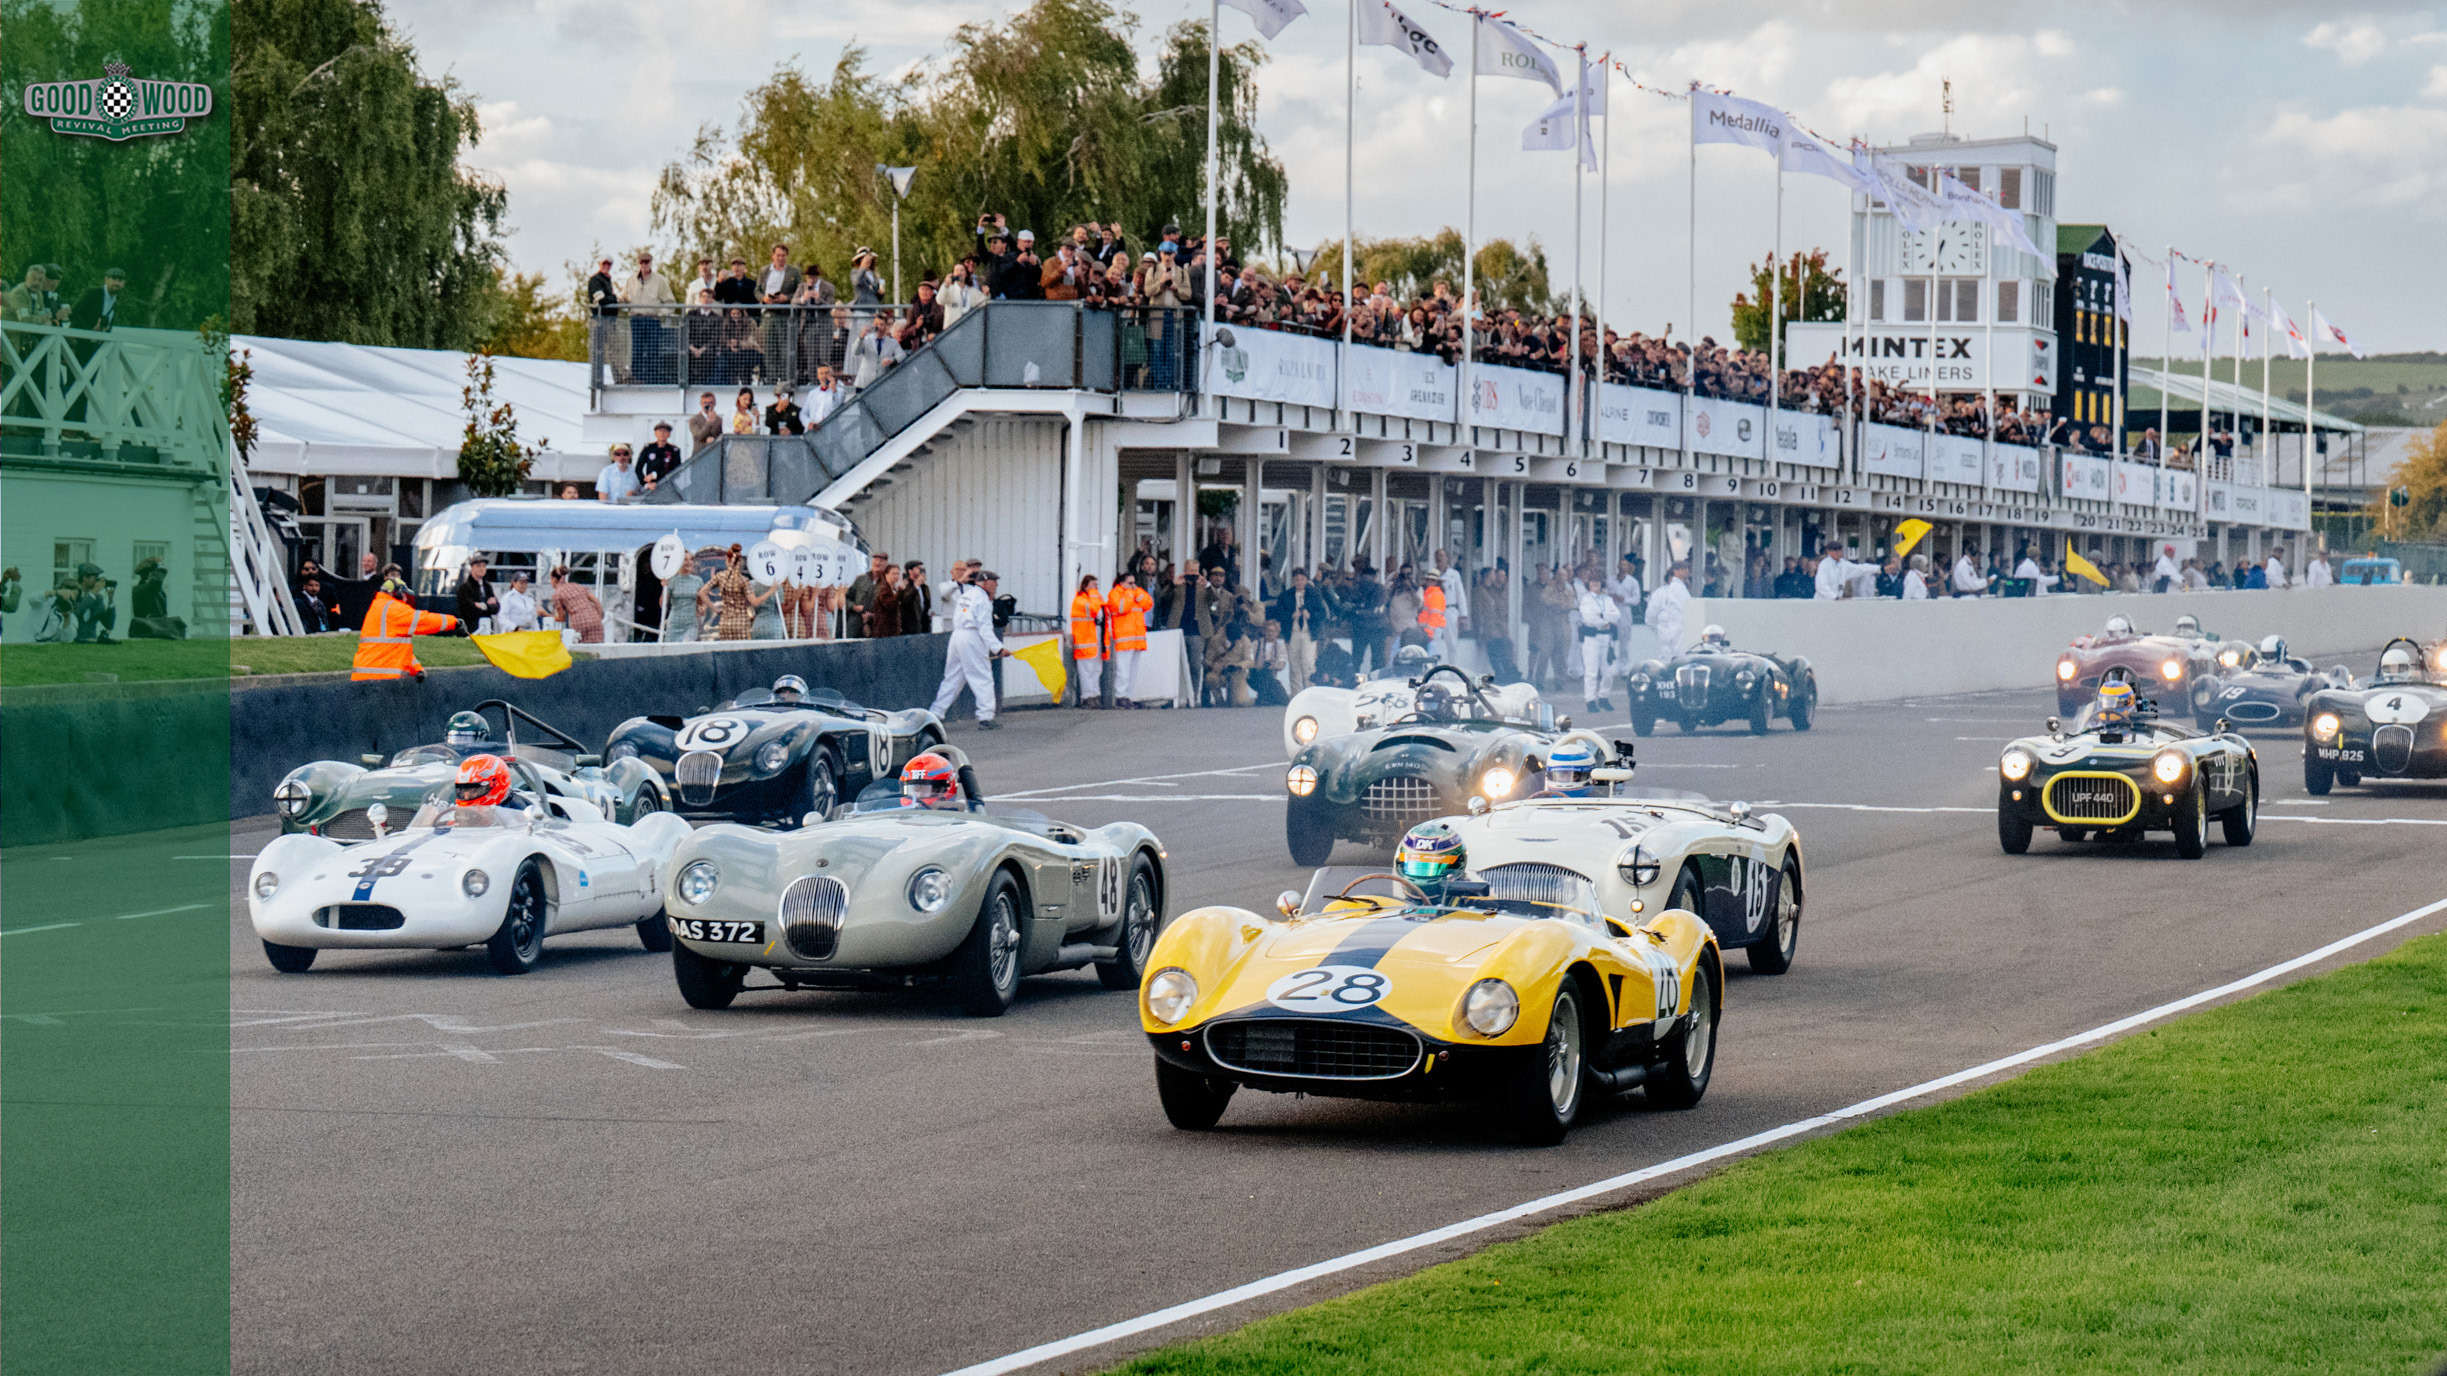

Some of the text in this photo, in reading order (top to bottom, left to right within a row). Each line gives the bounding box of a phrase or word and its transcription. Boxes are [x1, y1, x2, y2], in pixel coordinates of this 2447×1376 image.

[1709, 109, 1780, 138] Medallia
[1902, 231, 1911, 269] OLEX
[1973, 222, 1982, 270] ROLEX
[1842, 336, 1972, 359] MINTEX
[1908, 367, 1973, 381] LINERS
[1279, 431, 1285, 449] 1
[1340, 438, 1351, 455] 2
[1401, 445, 1412, 462] 3
[1460, 451, 1471, 467] 4
[1514, 457, 1525, 472] 5
[1566, 463, 1577, 477] 6
[1639, 469, 1648, 484] 7
[1684, 474, 1694, 488] 8
[1728, 479, 1737, 492] 9
[1759, 483, 1777, 497] 10
[1801, 487, 1815, 500] 11
[1835, 490, 1850, 504] 12
[1886, 496, 1901, 509] 14
[1919, 499, 1934, 512] 15
[1950, 502, 1965, 515] 16
[1979, 505, 1993, 517] 17
[2007, 508, 2022, 520] 18
[2035, 510, 2049, 522] 19
[2081, 515, 2096, 527] 20
[2107, 518, 2120, 530] 21
[2127, 520, 2142, 532] 22
[2151, 522, 2165, 534] 23
[2171, 525, 2185, 536] 24
[2192, 527, 2205, 538] 25
[663, 555, 671, 570] 7
[758, 551, 776, 560] ROW
[795, 554, 808, 562] ROW
[811, 553, 828, 562] ROW
[765, 561, 776, 576] 6
[796, 565, 803, 580] 4
[815, 564, 823, 579] 3
[2218, 686, 2246, 700] 19
[2386, 697, 2402, 711] 4
[684, 719, 739, 746] 18
[873, 723, 891, 774] 18
[2318, 748, 2364, 761] WHP 825
[910, 769, 927, 780] TIFF
[2072, 792, 2114, 804] UPF 440
[1601, 816, 1648, 840] 15
[1414, 839, 1436, 851] DK
[347, 857, 414, 878] 39
[1100, 856, 1118, 915] 48
[1748, 857, 1768, 918] 15
[708, 922, 756, 943] 372
[1276, 970, 1386, 1005] 28
